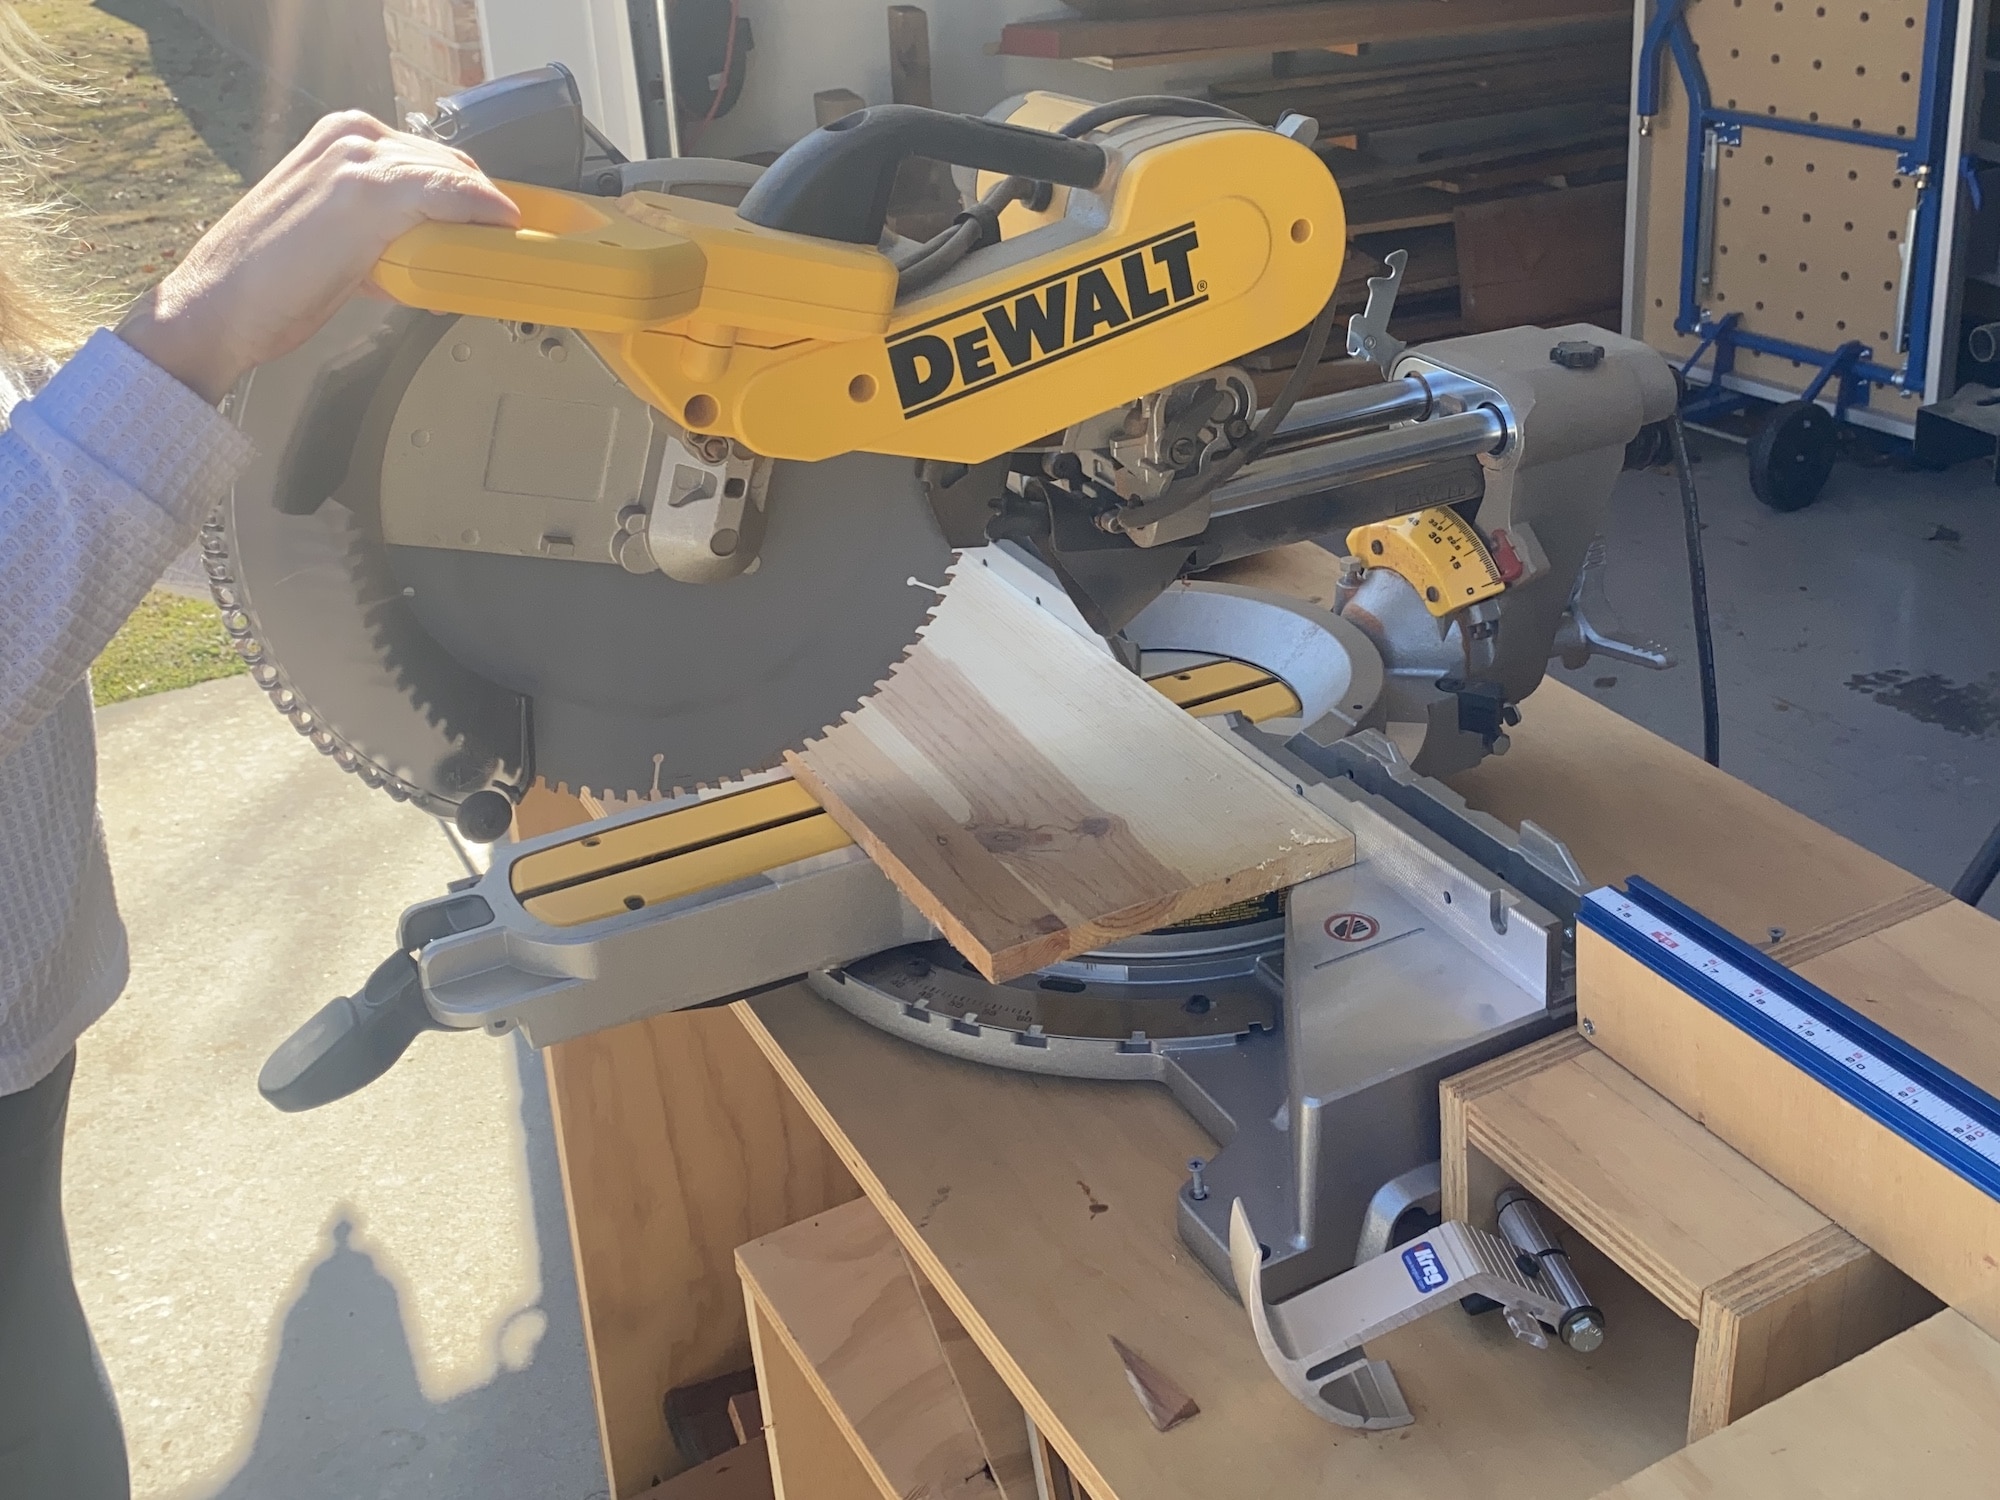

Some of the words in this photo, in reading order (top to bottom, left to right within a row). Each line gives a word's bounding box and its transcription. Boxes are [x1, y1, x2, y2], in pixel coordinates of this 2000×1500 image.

[1428, 531, 1442, 544] 30
[1449, 555, 1462, 570] 15
[1466, 587, 1475, 596] 0
[1413, 1248, 1444, 1286] Kreg
